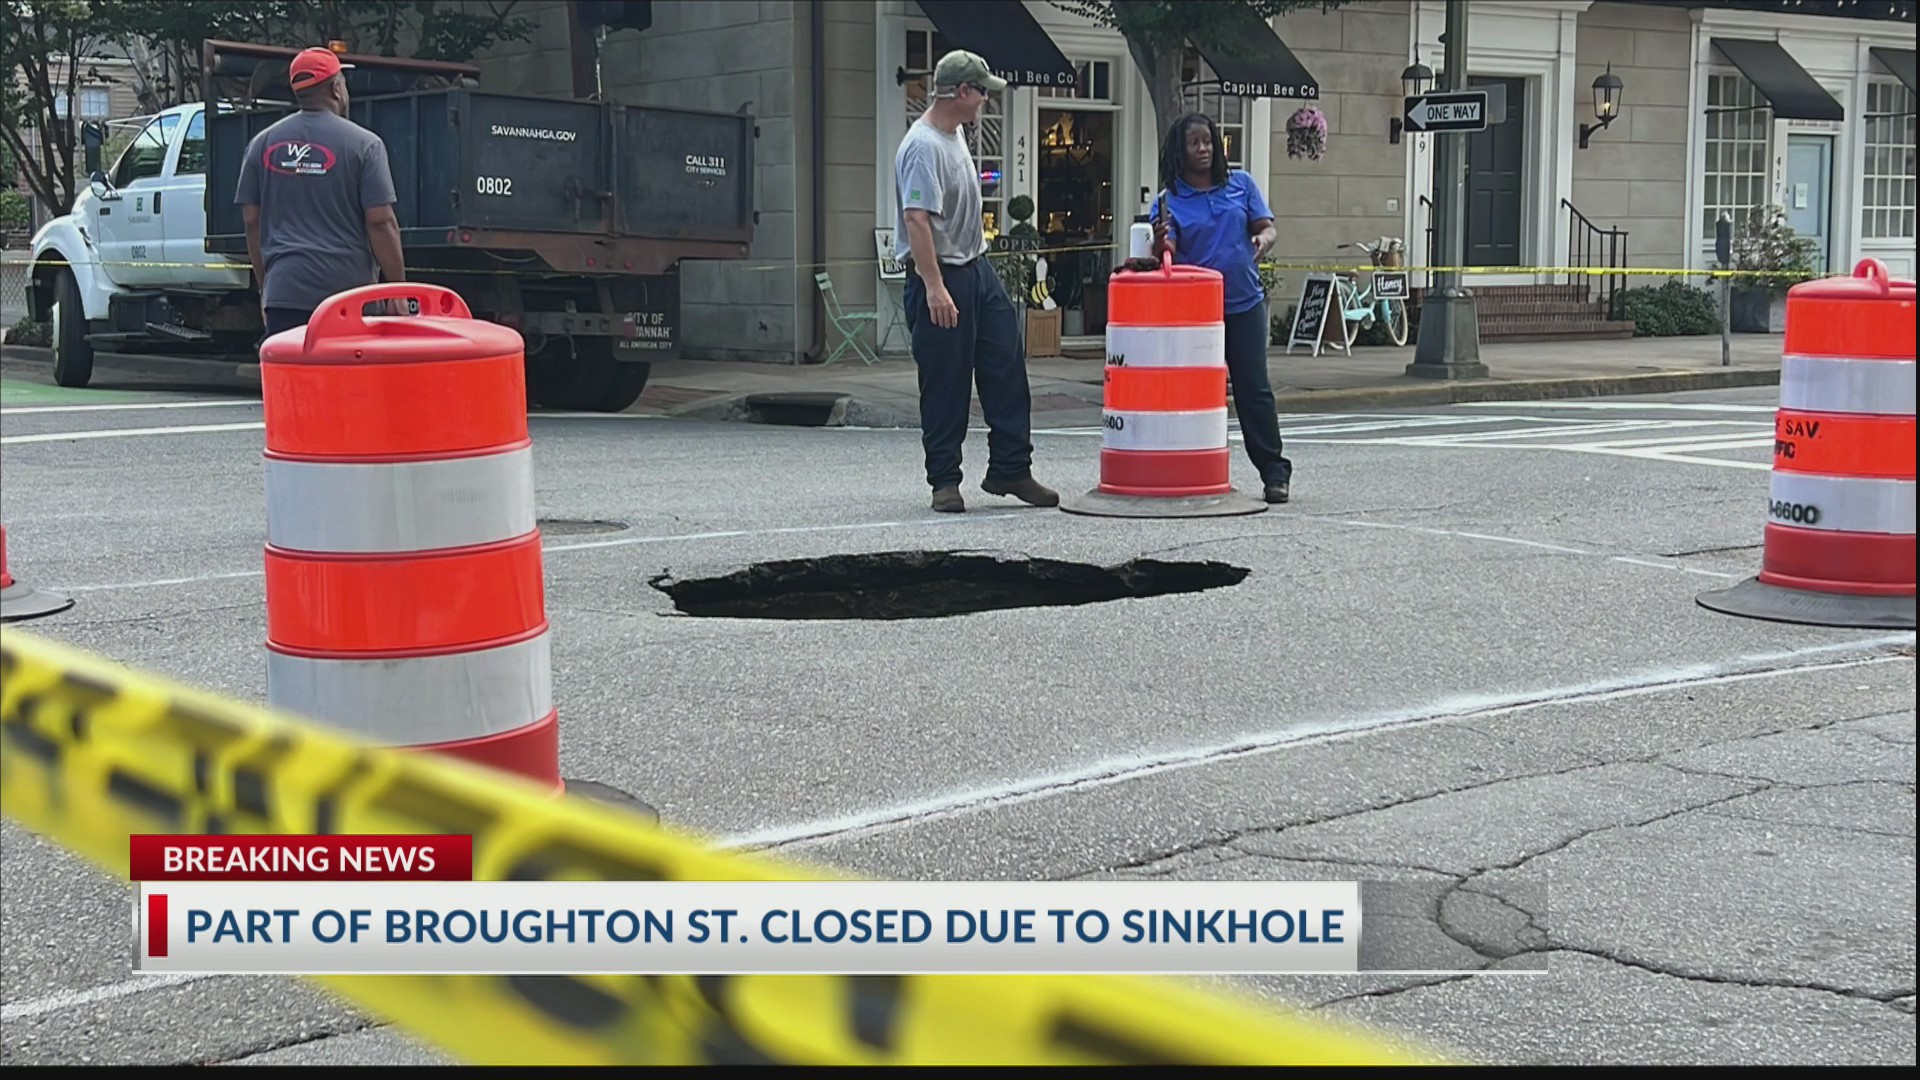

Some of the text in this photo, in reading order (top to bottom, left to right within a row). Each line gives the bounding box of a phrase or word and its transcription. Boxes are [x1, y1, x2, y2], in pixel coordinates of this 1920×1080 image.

[1026, 70, 1050, 84] Bee
[1224, 81, 1267, 95] Capital
[1273, 83, 1295, 96] Bee
[1427, 104, 1476, 120] ONE WAY
[491, 125, 576, 141] SAVANNAHGA.GOV
[685, 154, 725, 168] CALL 311
[1018, 136, 1026, 182] 421
[685, 165, 699, 174] CITY
[476, 176, 512, 196] 0802
[999, 238, 1041, 251] OPEN
[652, 313, 664, 325] OF
[1785, 419, 1823, 439] SAV.
